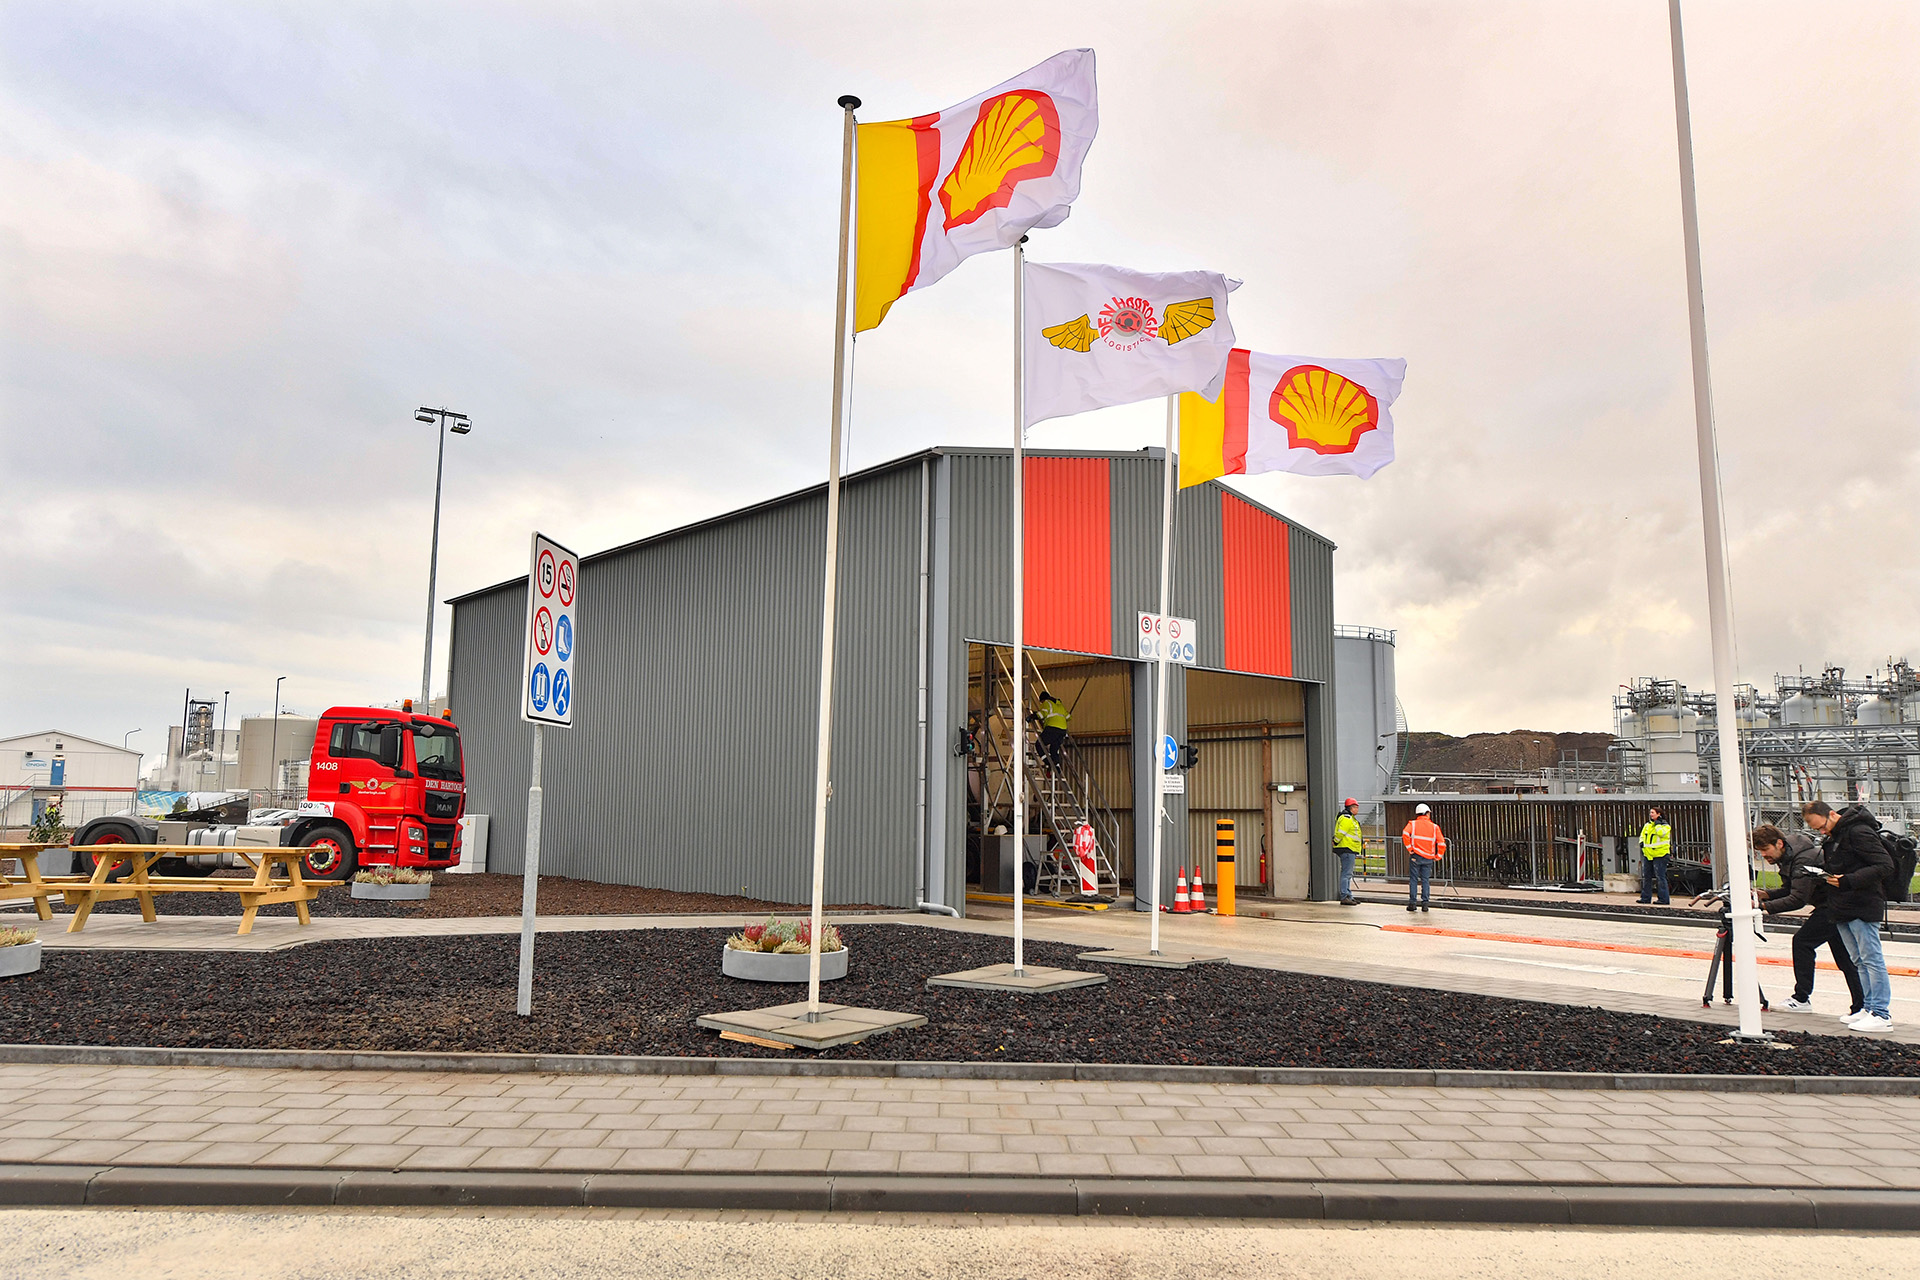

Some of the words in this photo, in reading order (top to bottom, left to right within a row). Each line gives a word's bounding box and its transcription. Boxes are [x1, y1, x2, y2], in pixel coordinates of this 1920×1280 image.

[1098, 303, 1117, 338] DEN
[1112, 296, 1158, 338] HARTOGH
[542, 562, 552, 585] 15
[1144, 620, 1150, 629] 5
[315, 762, 338, 771] 1408
[425, 779, 439, 789] DEN
[440, 781, 463, 791] HARTOGH
[436, 803, 452, 812] MAN
